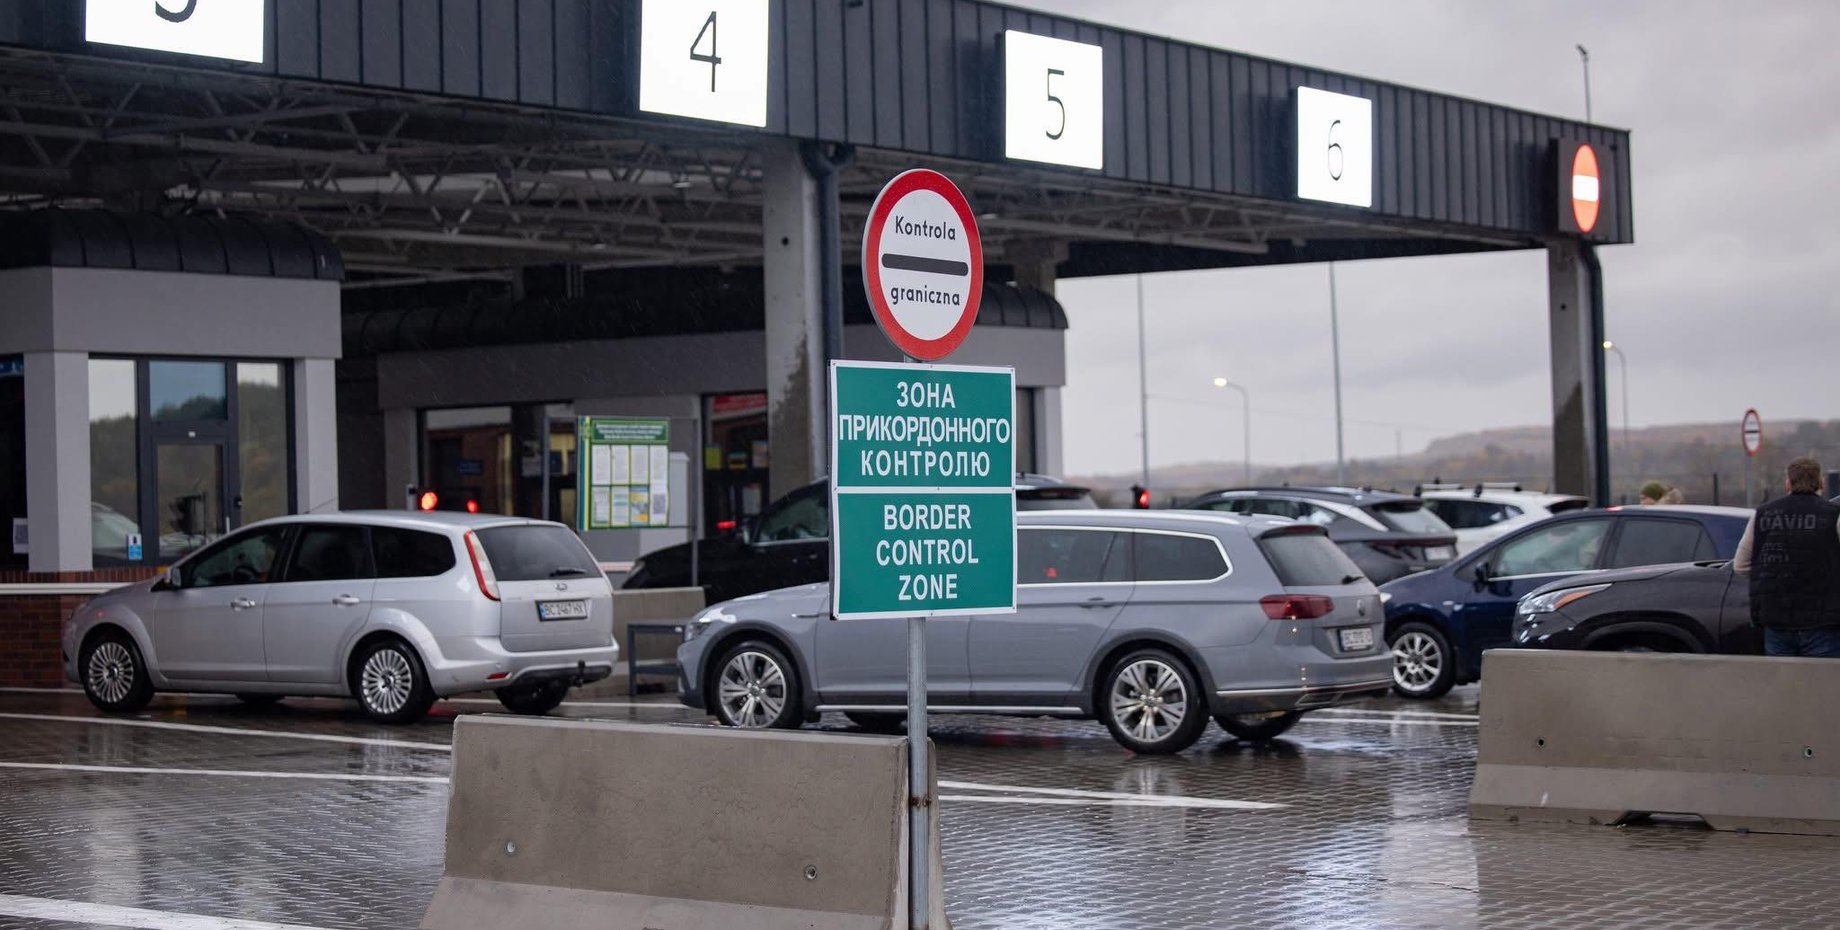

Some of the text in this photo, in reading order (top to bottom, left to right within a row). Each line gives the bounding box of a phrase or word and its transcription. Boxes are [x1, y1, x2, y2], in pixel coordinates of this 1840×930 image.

[689, 10, 722, 93] 4
[1045, 68, 1066, 141] 5
[1327, 119, 1344, 182] 6
[895, 215, 956, 241] Kontrola
[890, 284, 960, 307] graniczna
[896, 381, 956, 408] ЗОНА
[839, 414, 1010, 447] ПРИКОРДОННОГО
[861, 449, 991, 477] КОНТРОЛЮ
[884, 504, 972, 531] BORDER
[876, 538, 979, 566] CONTROL
[898, 573, 958, 601] ZONE
